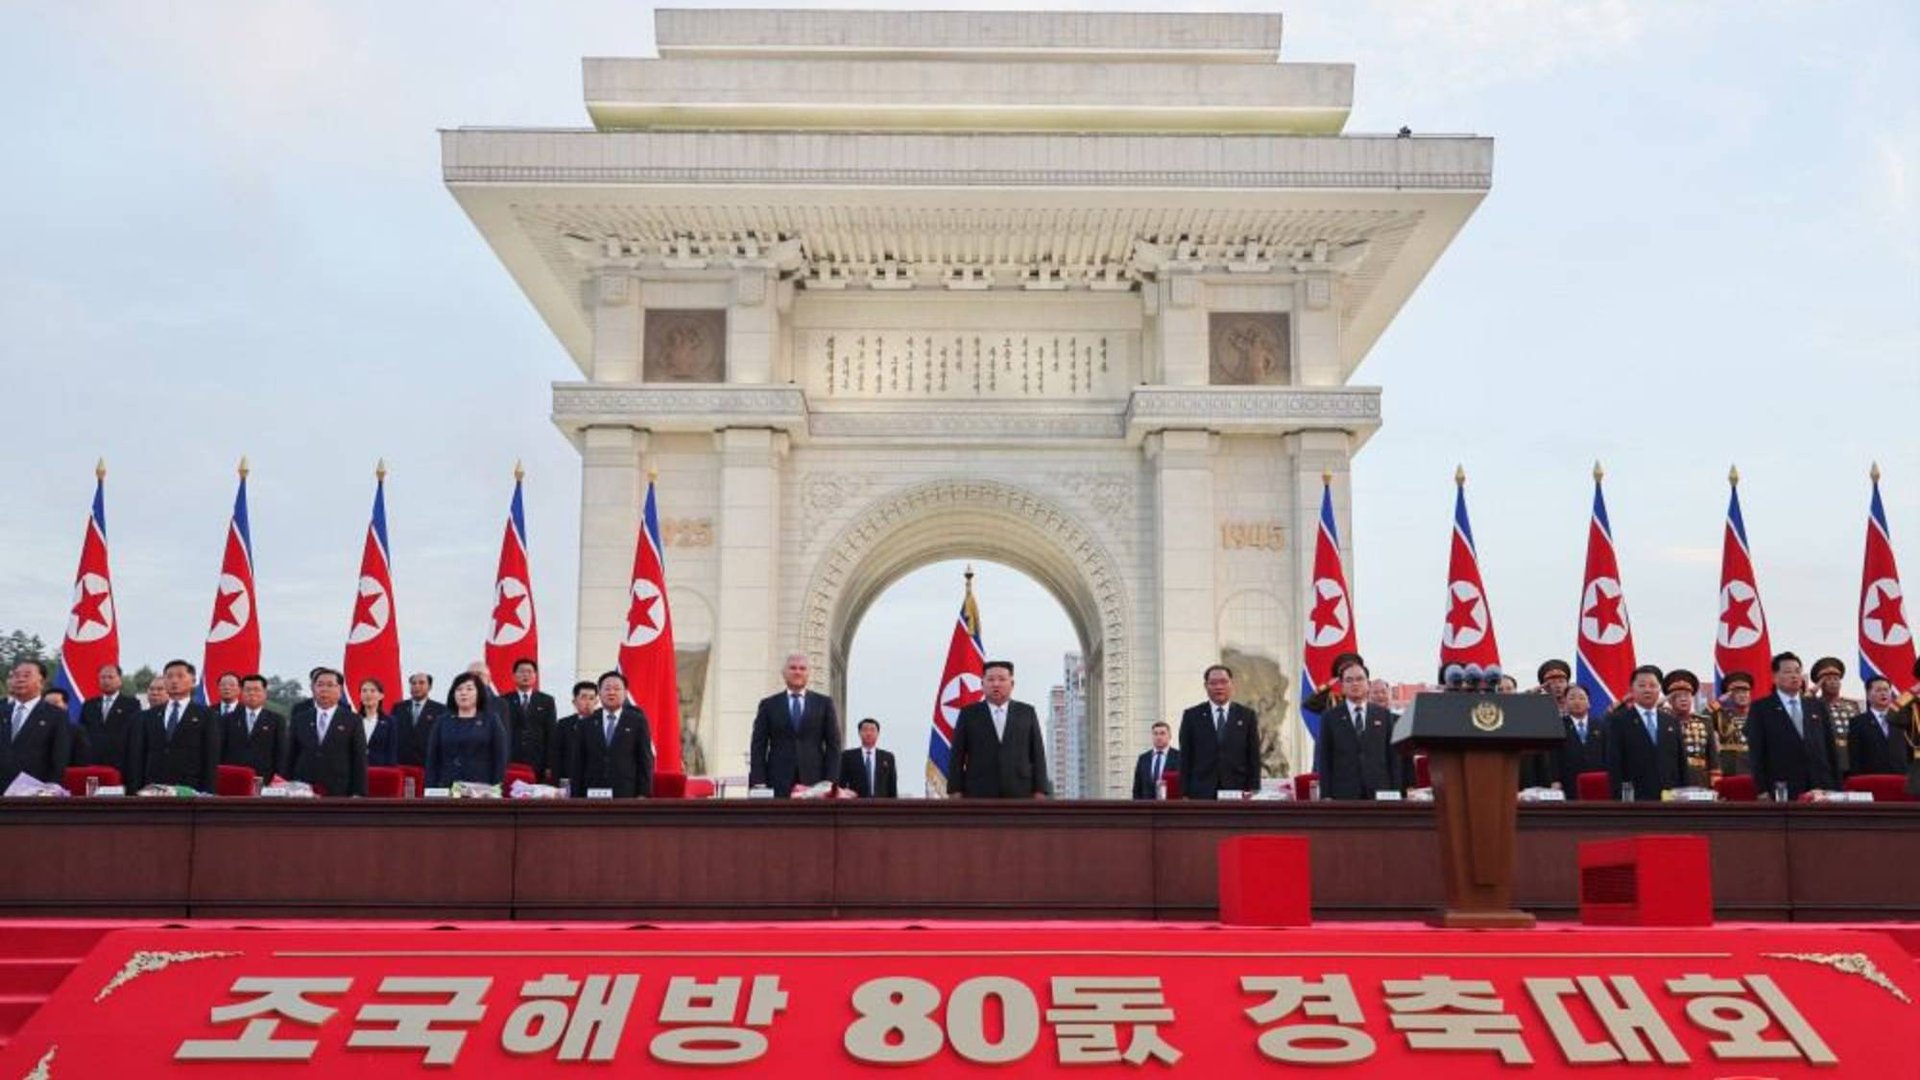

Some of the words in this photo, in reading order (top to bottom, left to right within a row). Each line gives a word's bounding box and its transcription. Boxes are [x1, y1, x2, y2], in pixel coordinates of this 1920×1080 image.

[661, 518, 714, 547] 925
[1221, 521, 1286, 551] 1945
[175, 973, 788, 1065] 조국해방
[844, 975, 1184, 1066] 80돐
[1241, 973, 1838, 1065] 경축대회
